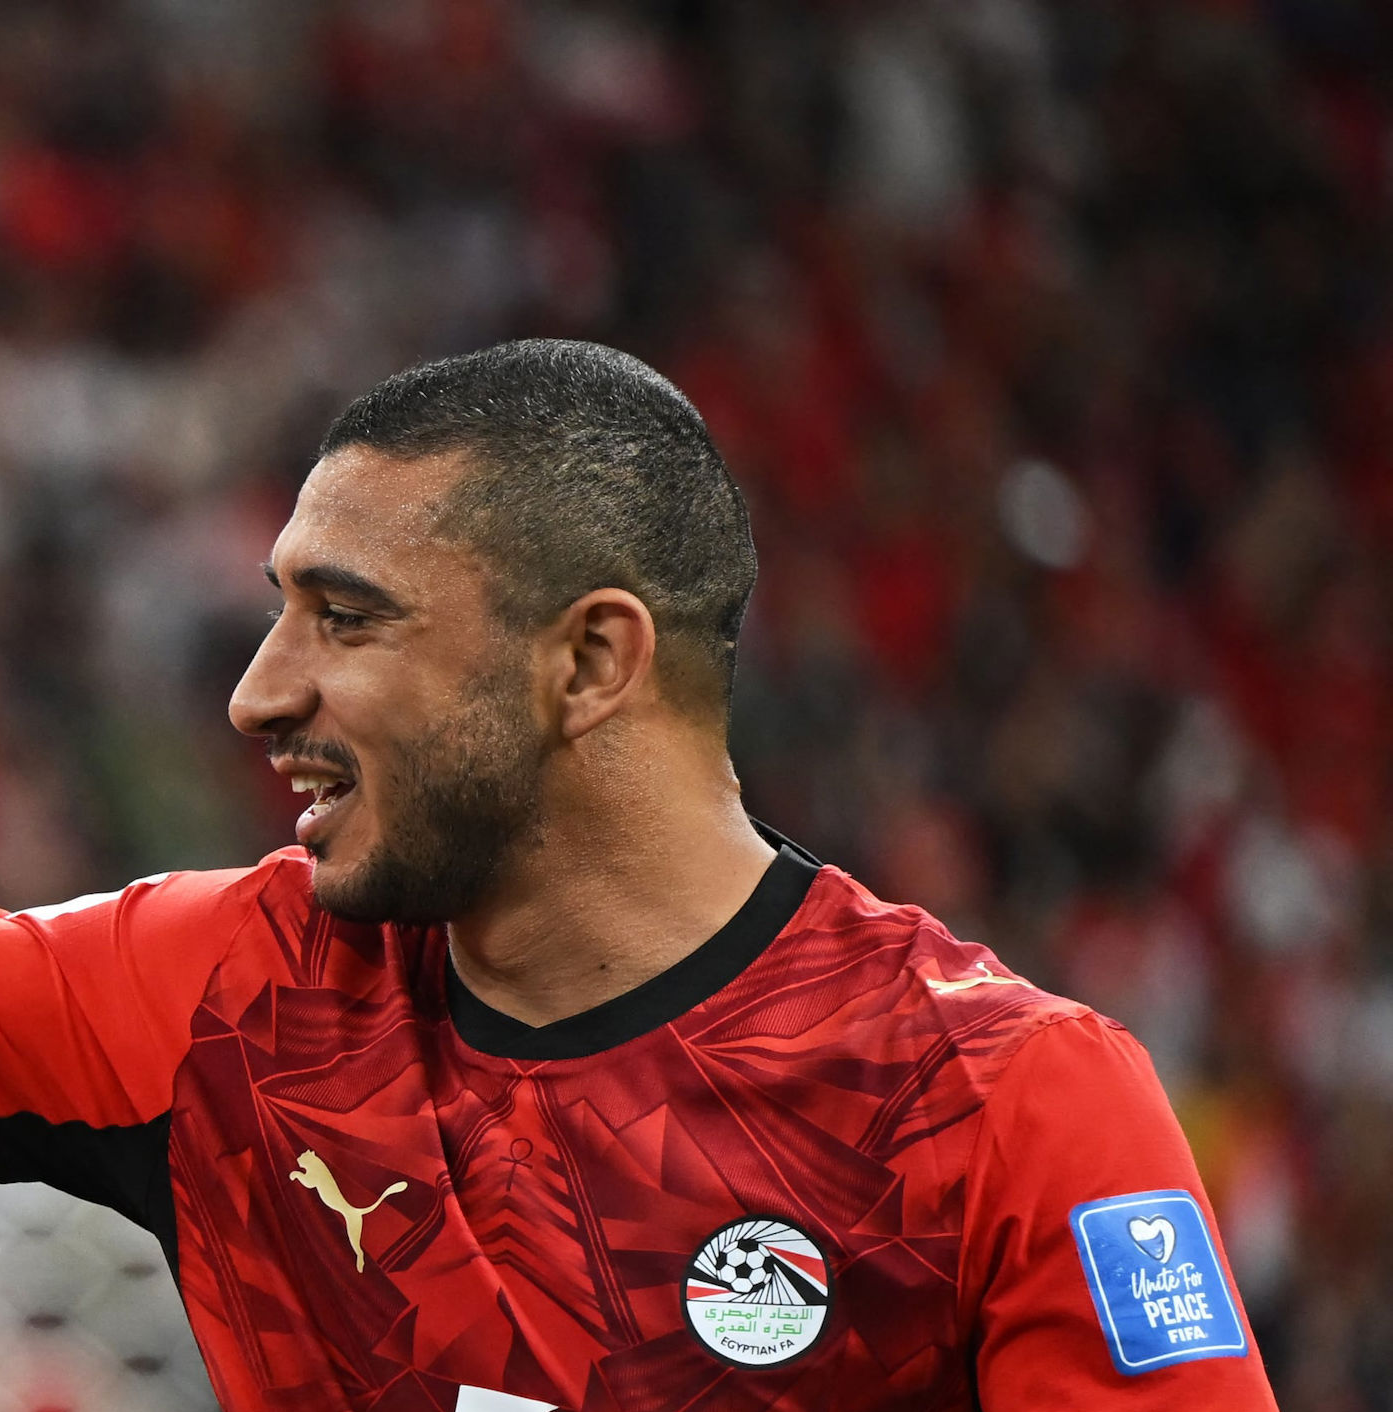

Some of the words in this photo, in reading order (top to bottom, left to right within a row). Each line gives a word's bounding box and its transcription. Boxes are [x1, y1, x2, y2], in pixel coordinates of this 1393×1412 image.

[1131, 1267, 1180, 1301] Unite
[1176, 1262, 1203, 1291] For
[1142, 1292, 1213, 1328] PEACE
[720, 1336, 777, 1356] EGYPTIAN
[779, 1339, 795, 1351] FA
[1167, 1325, 1207, 1344] FIFA
